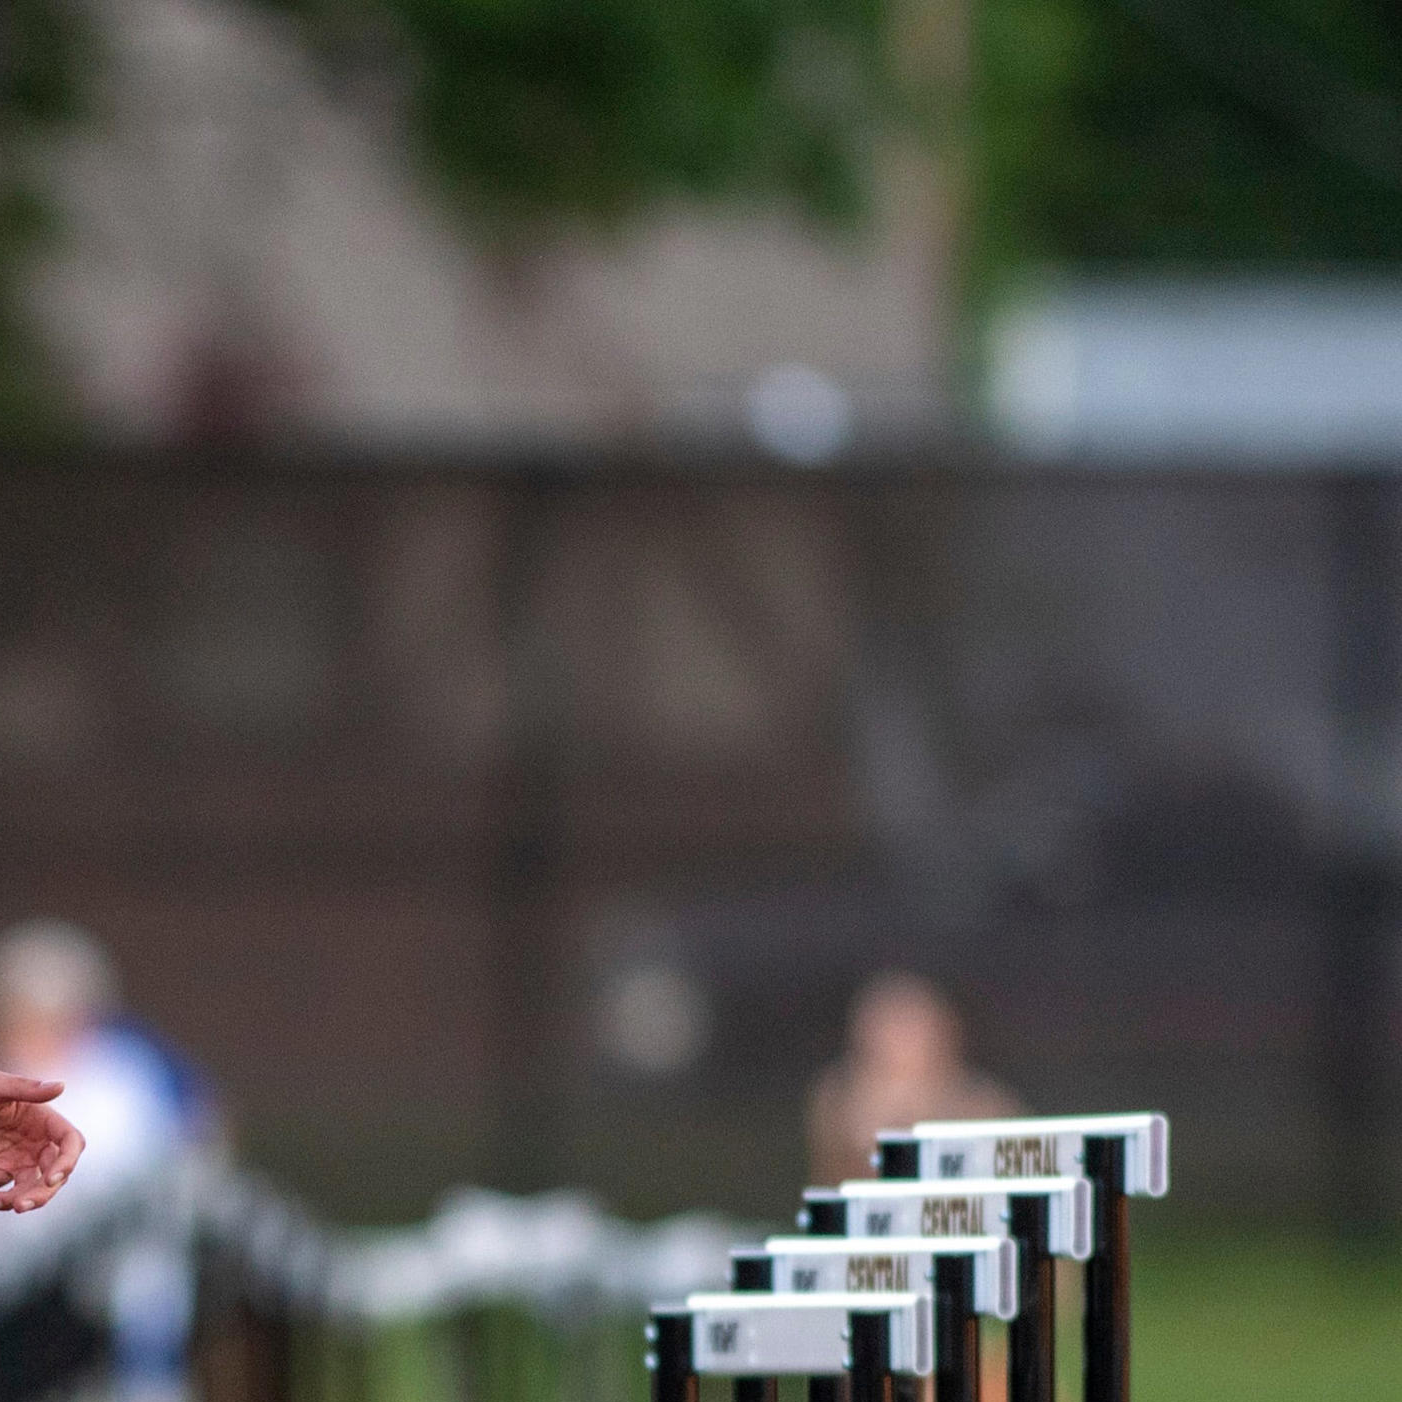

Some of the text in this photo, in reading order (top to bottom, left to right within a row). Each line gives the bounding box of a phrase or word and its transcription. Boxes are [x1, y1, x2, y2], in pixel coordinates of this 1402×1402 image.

[995, 1133, 1060, 1177] CENTRAL
[921, 1196, 987, 1238] CENTRAL
[846, 1254, 909, 1293] CENTRAL
